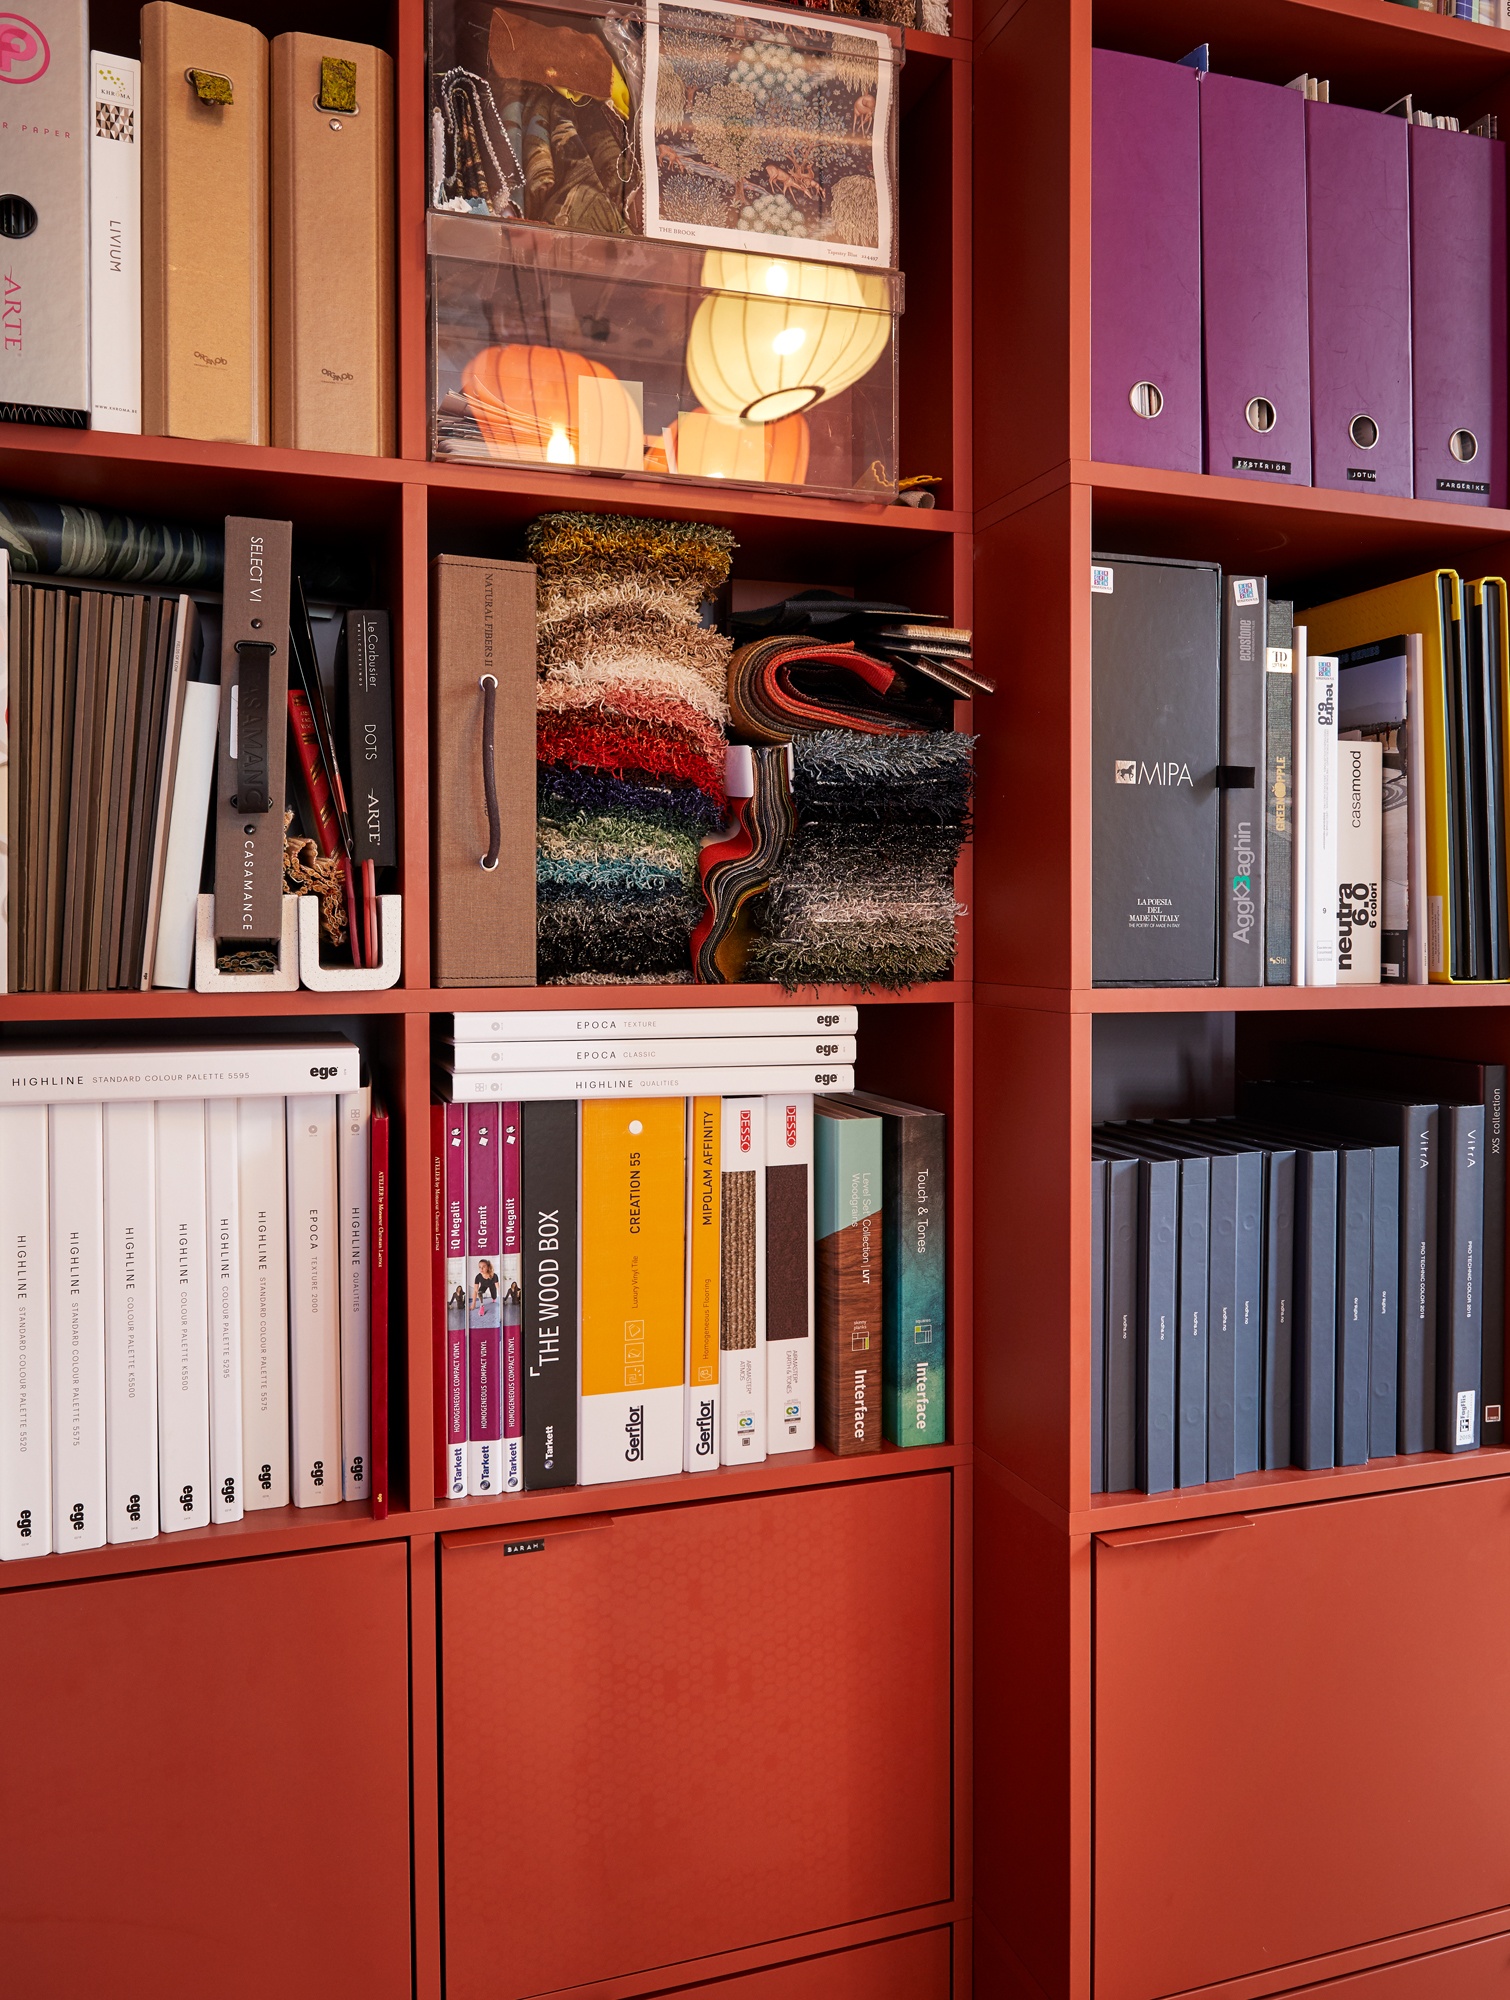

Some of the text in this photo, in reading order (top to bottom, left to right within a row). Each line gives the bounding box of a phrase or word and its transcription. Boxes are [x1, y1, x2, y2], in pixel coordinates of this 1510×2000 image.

[22, 125, 70, 138] PAPER
[109, 220, 122, 272] LIVIUM
[658, 227, 696, 237] THE BROOK
[2, 265, 22, 351] ARTE
[1352, 471, 1377, 480] JOTUN
[1441, 481, 1485, 491] FARGERIKE
[249, 536, 263, 602] SELECT VI
[484, 573, 493, 621] NATURAL
[484, 624, 493, 658] FIBERS
[1238, 619, 1251, 661] ecostone
[364, 724, 377, 760] DOTS
[1137, 761, 1194, 787] MIPA
[1350, 750, 1361, 828] casamood
[366, 788, 381, 843] ARTE
[243, 840, 254, 930] CASAMANCE
[1137, 898, 1172, 906] LA POESIA
[1352, 883, 1369, 926] 6.0
[1369, 883, 1377, 928] 6 colori
[1129, 914, 1180, 922] MADE IN ITALY
[1147, 906, 1163, 914] DEL
[1336, 883, 1352, 970] neutra
[576, 1021, 617, 1030] EPOCA
[816, 1013, 840, 1027] ege
[576, 1051, 616, 1060] EPOCA
[815, 1043, 839, 1056] ege
[12, 1076, 84, 1087] HIGHLINE
[92, 1075, 141, 1083] STANDARD
[144, 1074, 183, 1082] COLOUR
[227, 1072, 250, 1080] 5595
[310, 1065, 338, 1080] ege
[575, 1072, 838, 1090] HIGHLINE QUALITIES ege
[740, 1110, 751, 1153] DESSO
[786, 1105, 796, 1148] DESSO
[1491, 1088, 1501, 1154] XXS collection
[702, 1111, 714, 1226] MIPOLAM AFFINITY
[1420, 1130, 1429, 1169] VitrA
[1467, 1129, 1476, 1168] VitrA
[629, 1152, 641, 1234] CREATION 55
[849, 1172, 861, 1227] Woodgrains
[917, 1168, 929, 1253] Touch & Tones
[258, 1211, 267, 1271] HIGHLINE
[309, 1209, 318, 1250] EPOCA
[450, 1200, 462, 1250] iQ Megalit
[477, 1205, 488, 1248] iQ Granit
[505, 1198, 517, 1247] iQ Megalit
[862, 1172, 871, 1284] Level Set Collection LVT
[125, 1227, 135, 1289] HIGHLINE
[179, 1223, 188, 1285] HIGHLINE
[220, 1218, 229, 1279] HIGHLINE
[352, 1207, 360, 1313] HIGHLINE QUALITIES
[537, 1209, 560, 1367] THE WOOD BOX
[631, 1255, 640, 1309] Luxury Vinyl Tile
[70, 1232, 80, 1447] HIGHLINE STANDARD COLOUR PALETTE 5575
[702, 1278, 712, 1360] Homogeneous Flooring
[17, 1235, 28, 1453] HIGHLINE STANDARD COLOUR PALETTE 5520
[127, 1334, 135, 1369] PALETTE
[128, 1372, 136, 1398] K5500
[260, 1392, 268, 1412] 5575
[854, 1369, 868, 1438] Interface
[916, 1362, 929, 1429] Interface
[545, 1425, 554, 1460] Tarkett
[625, 1405, 641, 1462] Gerflor
[696, 1400, 711, 1456] Gerflor
[258, 1463, 271, 1490] ege
[311, 1460, 323, 1487] ege
[350, 1456, 363, 1482] ege
[453, 1447, 462, 1482] Tarkett
[481, 1445, 489, 1480] Tarkett
[508, 1442, 517, 1477] Tarkett
[126, 1494, 141, 1522] ege
[179, 1485, 193, 1512] ege
[221, 1476, 235, 1504] ege
[17, 1509, 32, 1538] ege
[70, 1503, 84, 1531] ege
